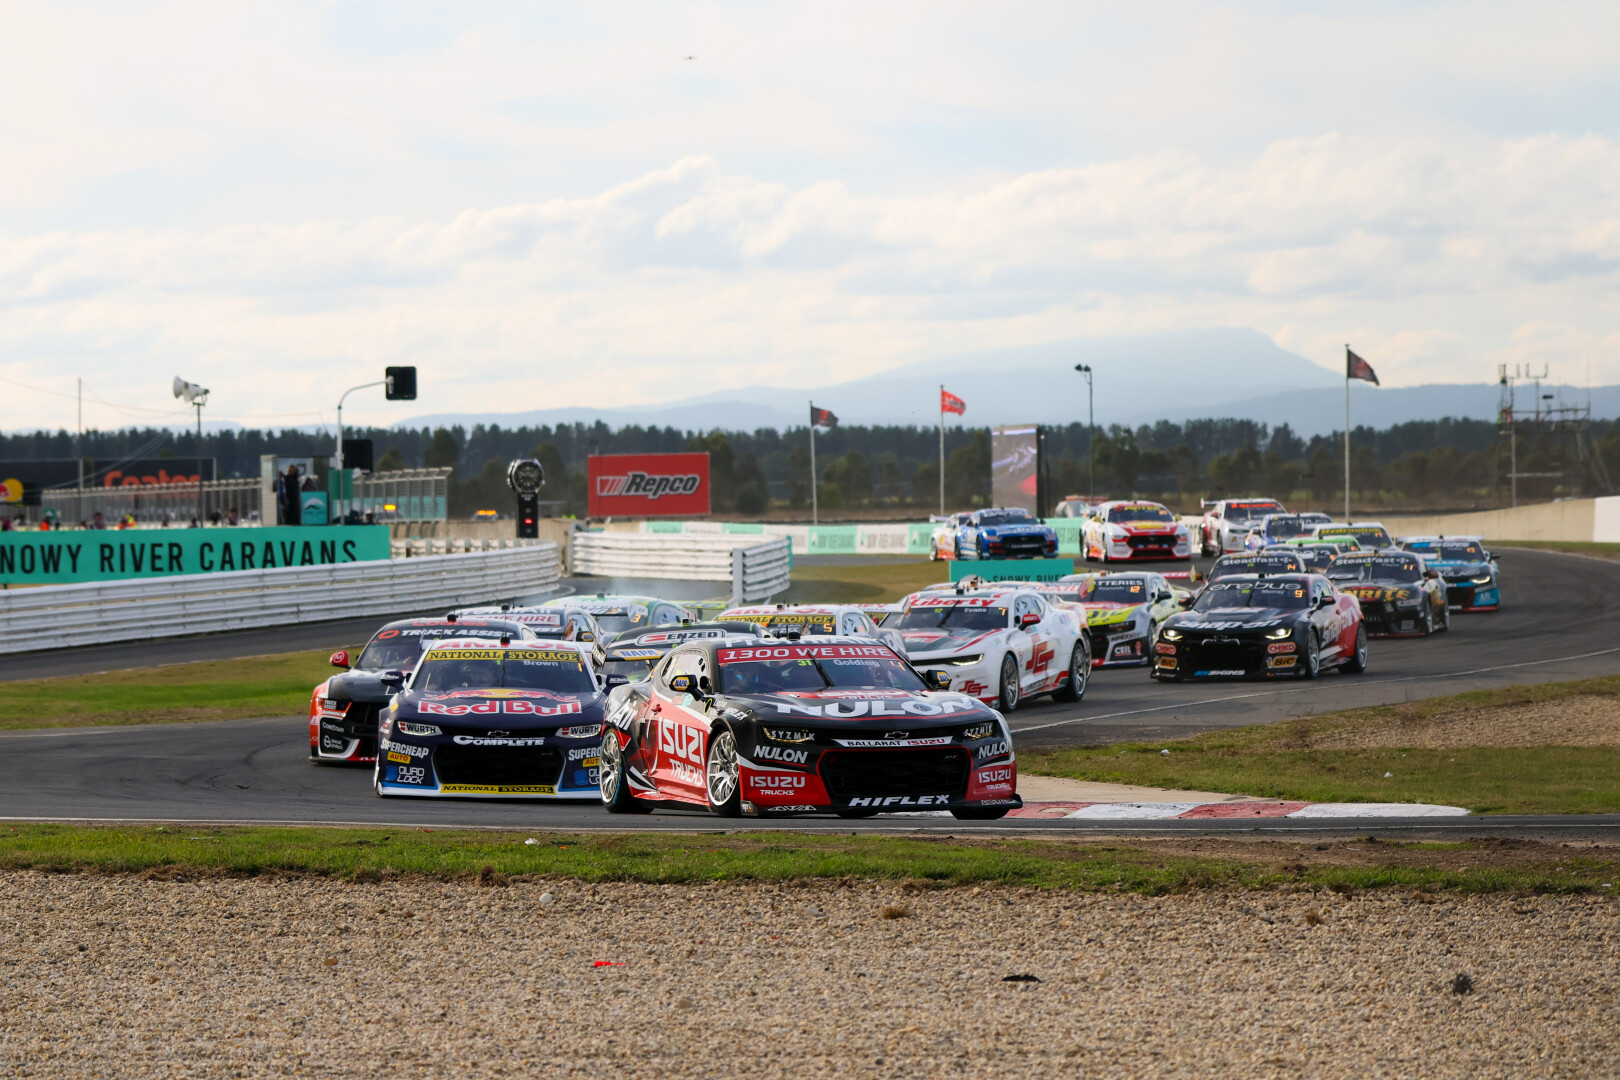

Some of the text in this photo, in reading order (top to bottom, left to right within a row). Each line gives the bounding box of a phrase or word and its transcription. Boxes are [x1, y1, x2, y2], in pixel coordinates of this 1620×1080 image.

[622, 471, 701, 499] Repco
[0, 540, 358, 574] NOWY RIVER CARAVANS
[1294, 589, 1303, 598] 9
[1340, 589, 1410, 600] NRITE
[911, 598, 995, 607] Liberty
[630, 614, 641, 623] 3
[401, 628, 514, 638] TRUCK ASSIST
[823, 623, 833, 632] 5
[667, 631, 717, 640] ENZED
[436, 641, 576, 651] AMOL
[430, 651, 577, 661] NATIONAL STORAGE
[723, 647, 892, 660] 1300 WE HIRE
[798, 659, 812, 667] 31
[833, 659, 880, 668] Golding
[418, 700, 582, 717] Red Bull
[777, 697, 974, 718] NULON
[771, 730, 815, 741] SYZMIK
[963, 724, 993, 737] SYZMIK
[907, 738, 945, 746] ISUZU
[380, 738, 430, 759] SUPERCHEAP
[568, 747, 600, 761] SUPERC
[389, 753, 409, 762] AUTO
[753, 745, 808, 764] NULON
[585, 758, 600, 766] AUT
[398, 766, 425, 777] QUAD
[669, 757, 705, 787] TRUCKS
[978, 768, 1011, 784] ISUZU
[397, 775, 424, 785] LOCK
[750, 775, 806, 788] ISUZU
[502, 786, 553, 794] STORAGE
[848, 794, 950, 807] HIFLEX
